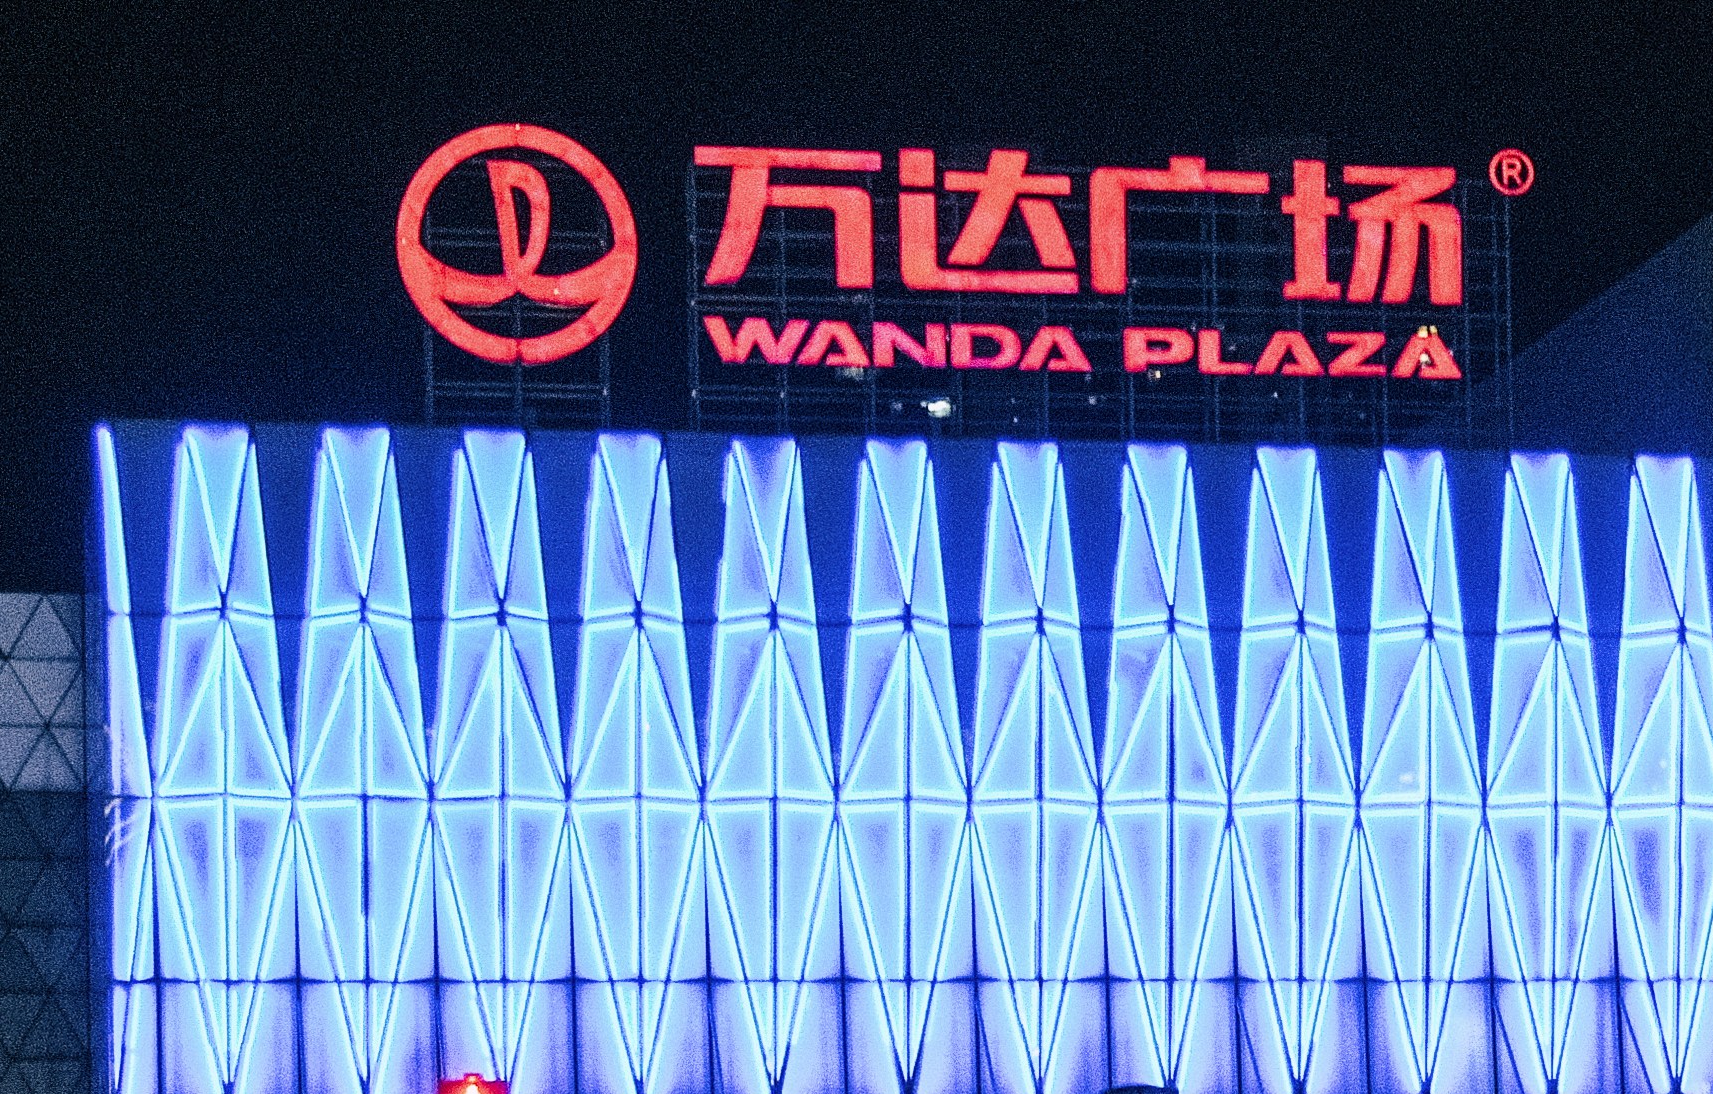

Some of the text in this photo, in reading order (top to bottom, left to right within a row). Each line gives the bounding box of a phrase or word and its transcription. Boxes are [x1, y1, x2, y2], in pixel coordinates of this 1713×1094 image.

[694, 145, 1462, 305] 万达广场
[703, 314, 1462, 379] WANDA PLAZA
